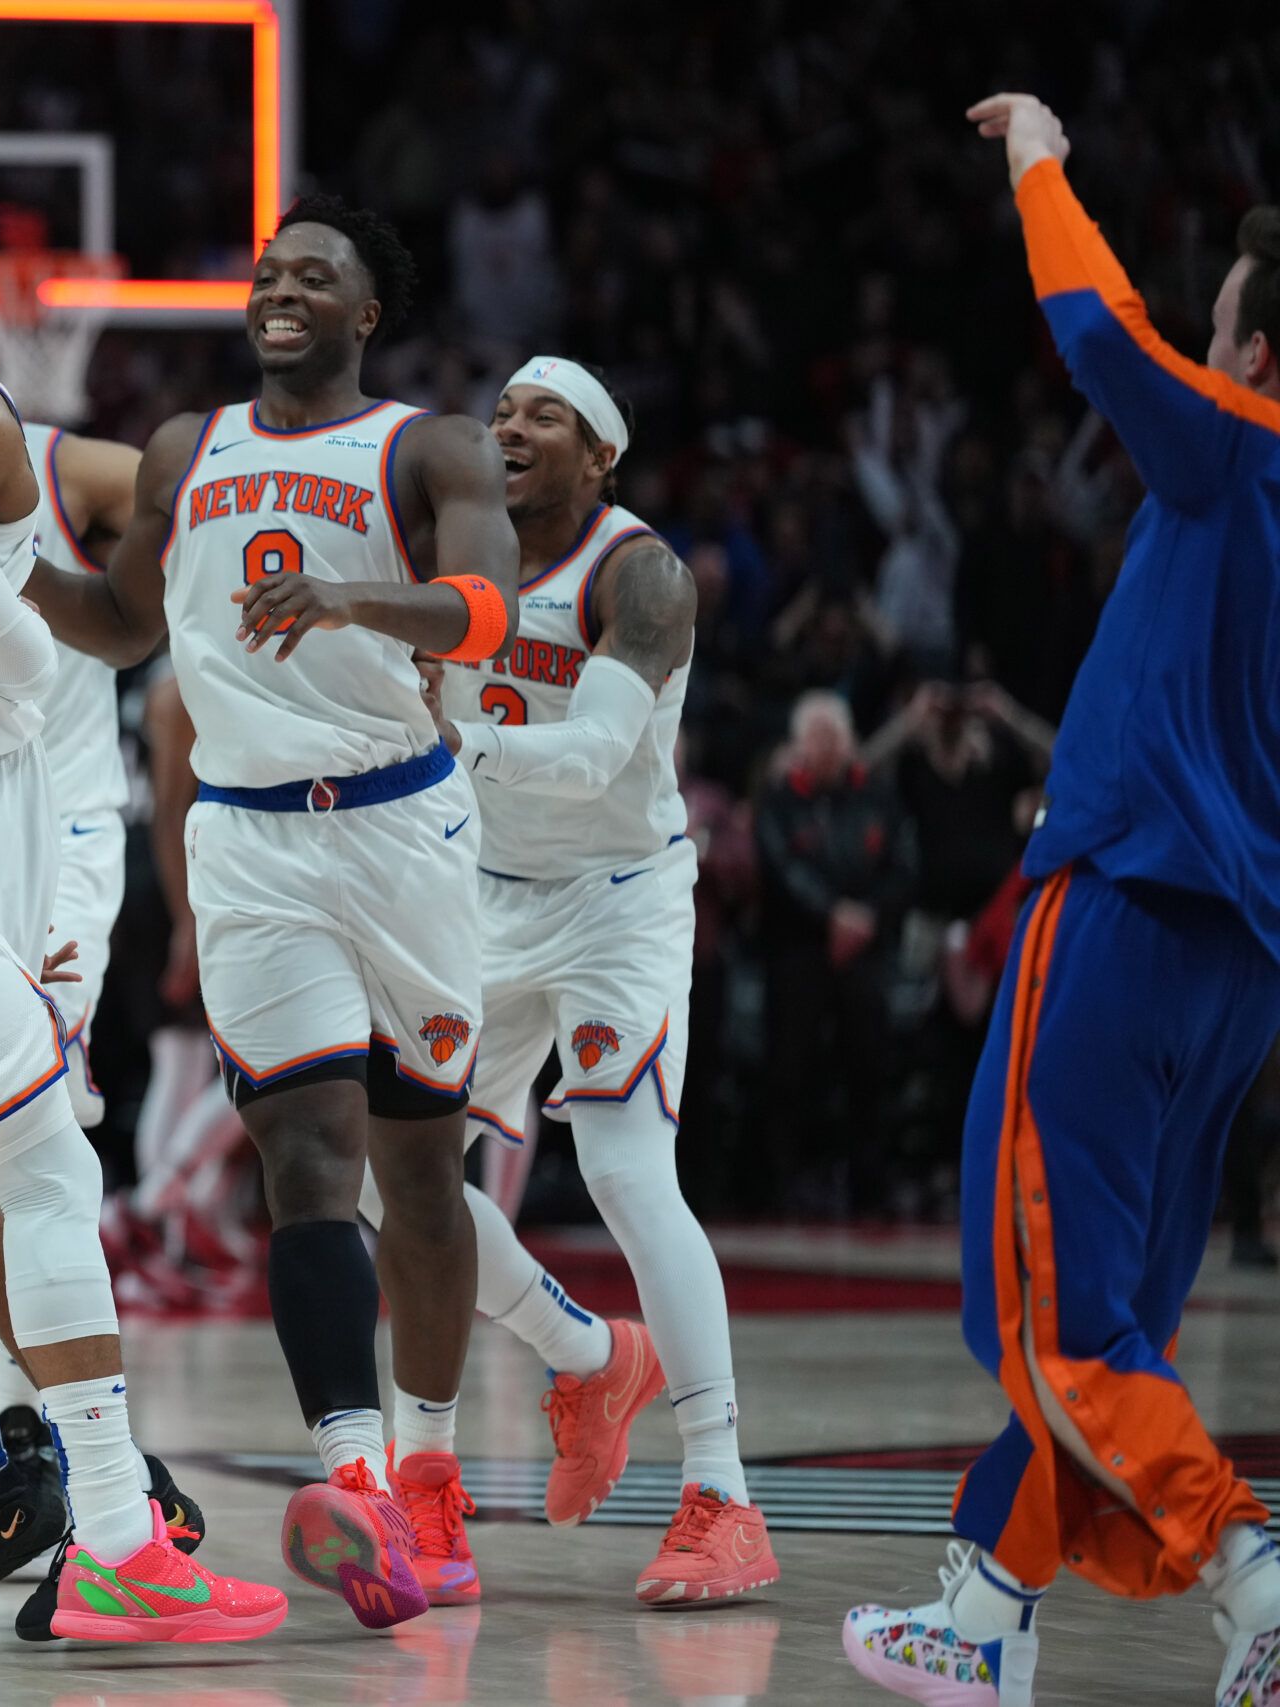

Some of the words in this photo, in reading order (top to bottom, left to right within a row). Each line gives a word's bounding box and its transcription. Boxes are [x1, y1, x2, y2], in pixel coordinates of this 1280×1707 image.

[189, 471, 271, 531] NEW
[272, 470, 375, 536] YORK
[418, 1014, 469, 1045] KNICKS
[572, 1024, 619, 1052] KNICKS
